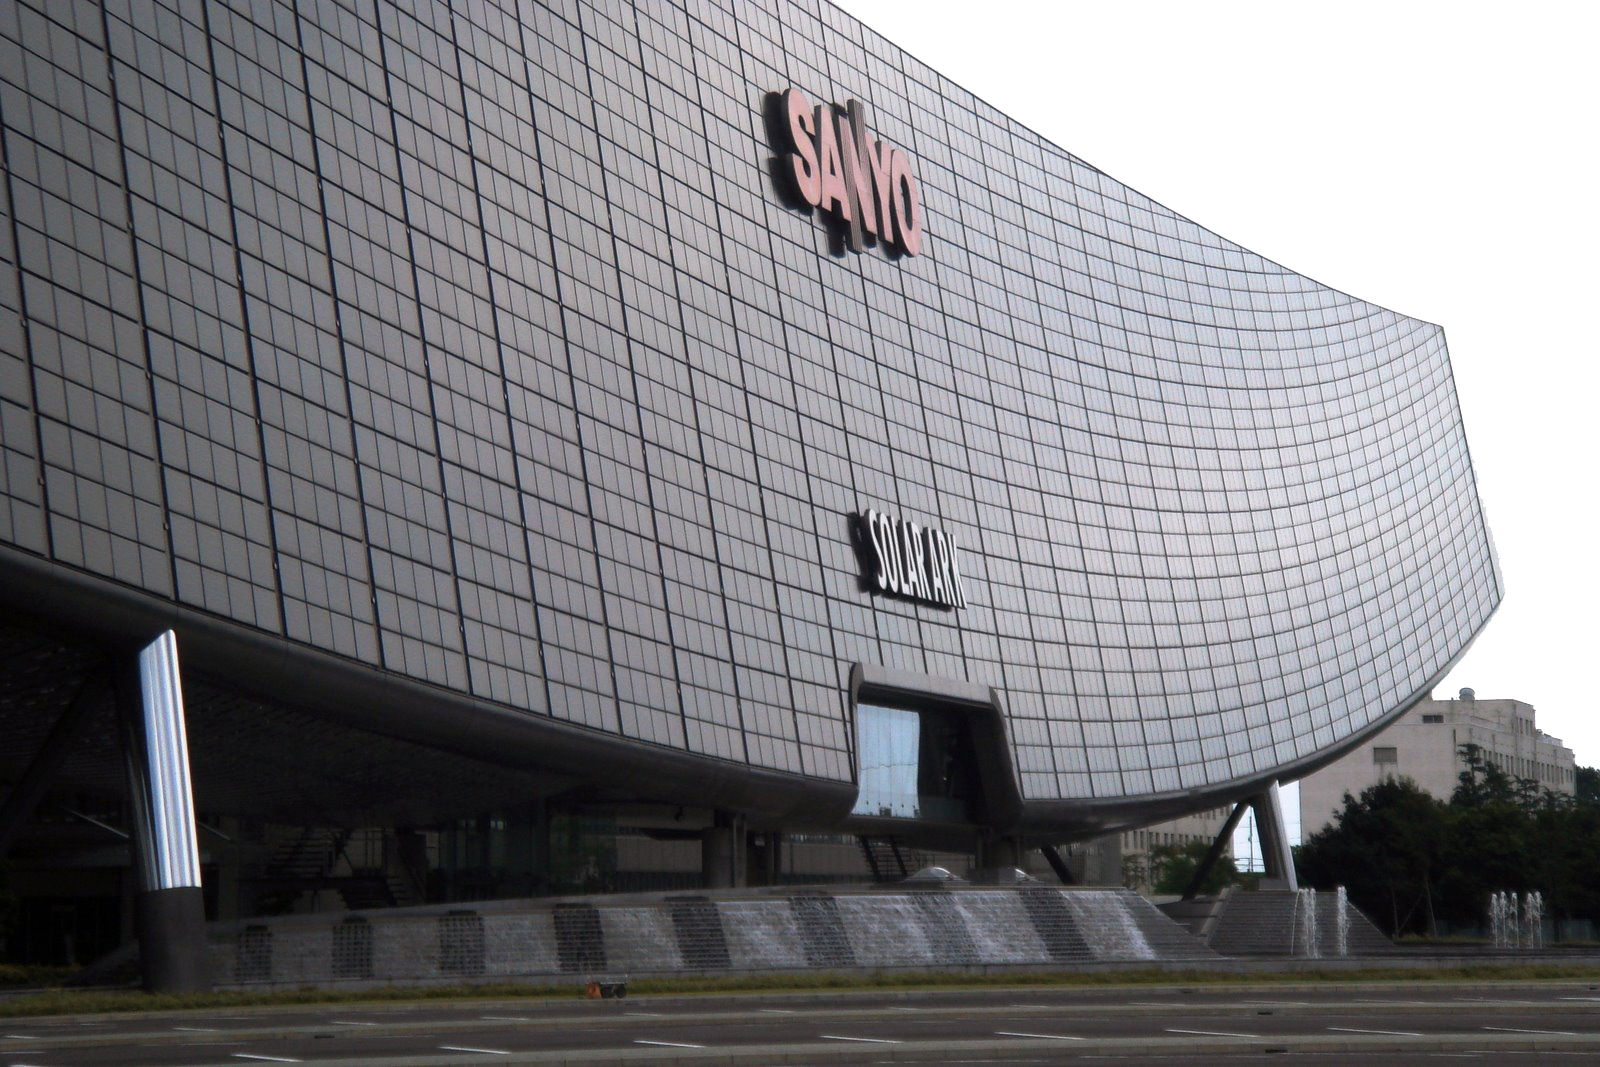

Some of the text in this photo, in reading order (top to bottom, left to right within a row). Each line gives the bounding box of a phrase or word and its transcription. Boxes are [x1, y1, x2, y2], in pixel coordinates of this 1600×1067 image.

[785, 87, 922, 257] SANYO
[868, 508, 967, 609] SOLAR ARK
